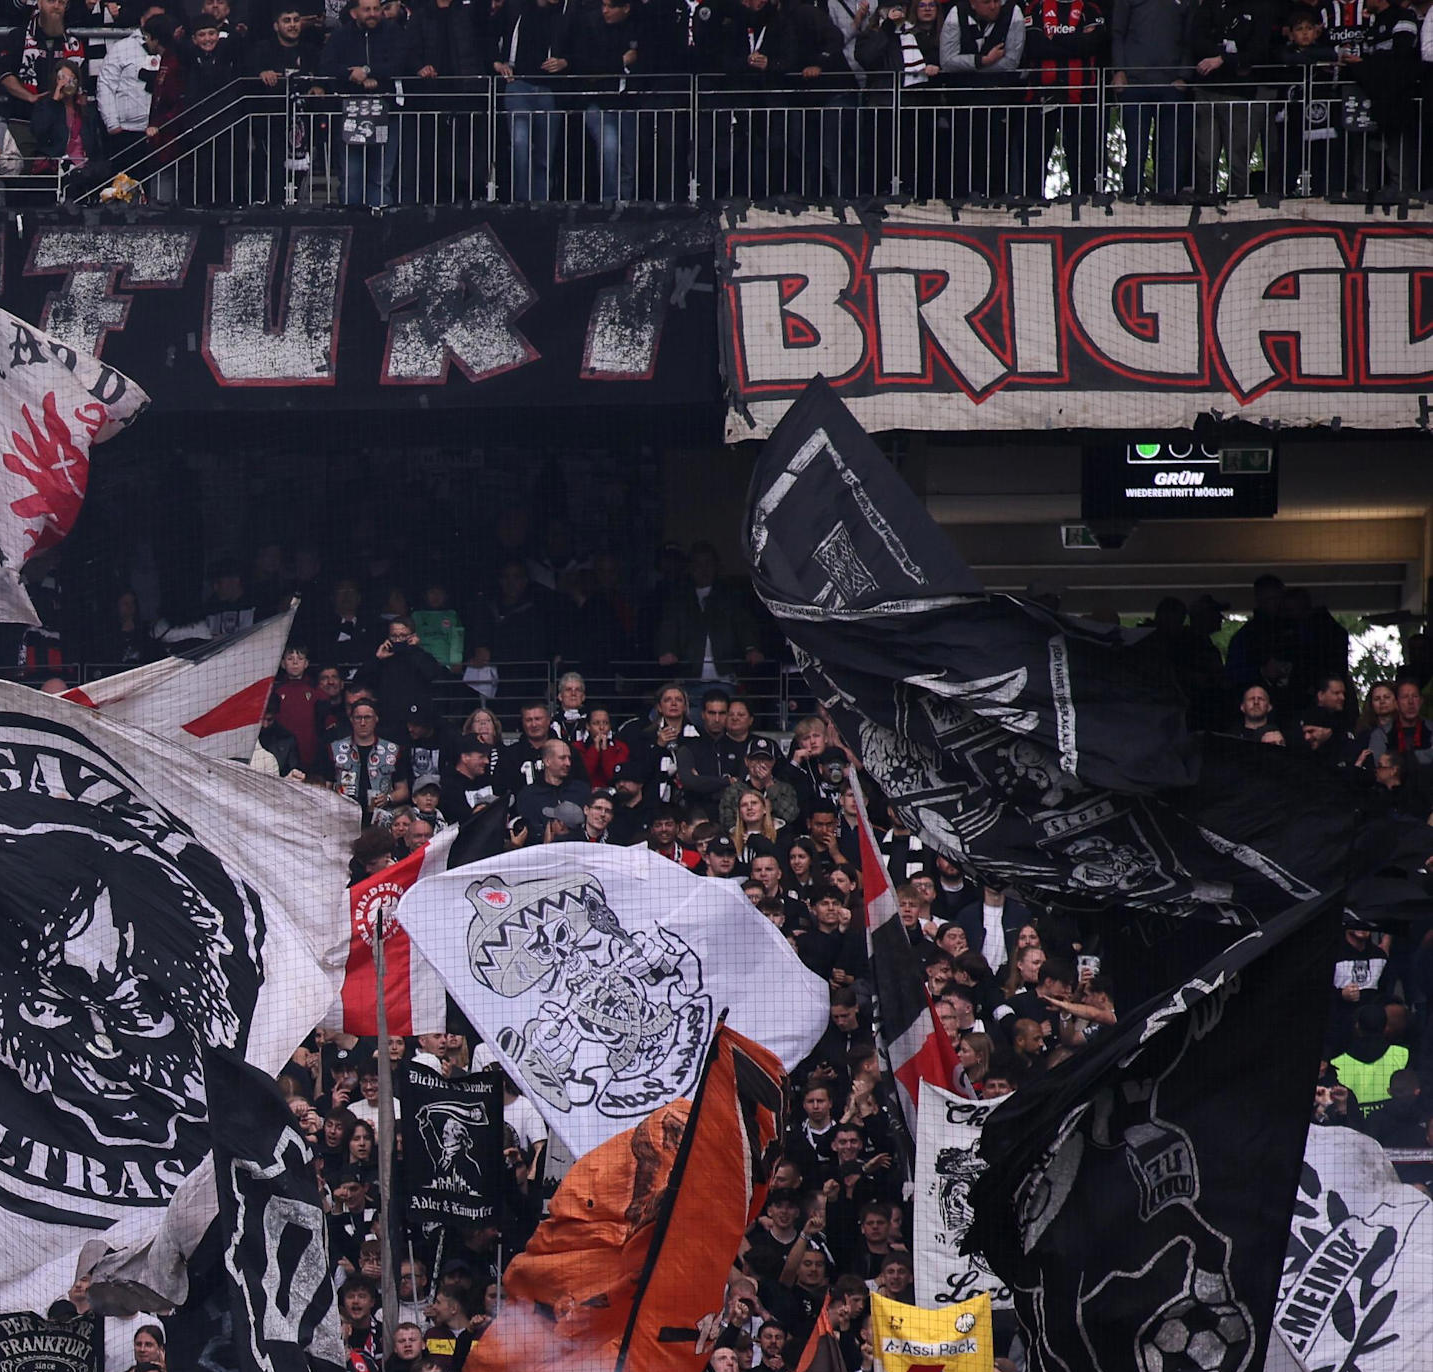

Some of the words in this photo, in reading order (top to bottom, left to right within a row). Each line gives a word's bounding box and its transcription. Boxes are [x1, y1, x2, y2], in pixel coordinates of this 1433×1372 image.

[1154, 470, 1205, 486] GRÜN
[1126, 488, 1193, 498] WIEDEREINTRITT
[1194, 486, 1234, 498] MÖGLICH
[1052, 806, 1105, 834] STOP
[411, 1195, 441, 1210] Adler
[0, 1317, 38, 1337] PER
[901, 1341, 935, 1357] Assi
[940, 1340, 977, 1355] Pack
[34, 1361, 57, 1370] since
